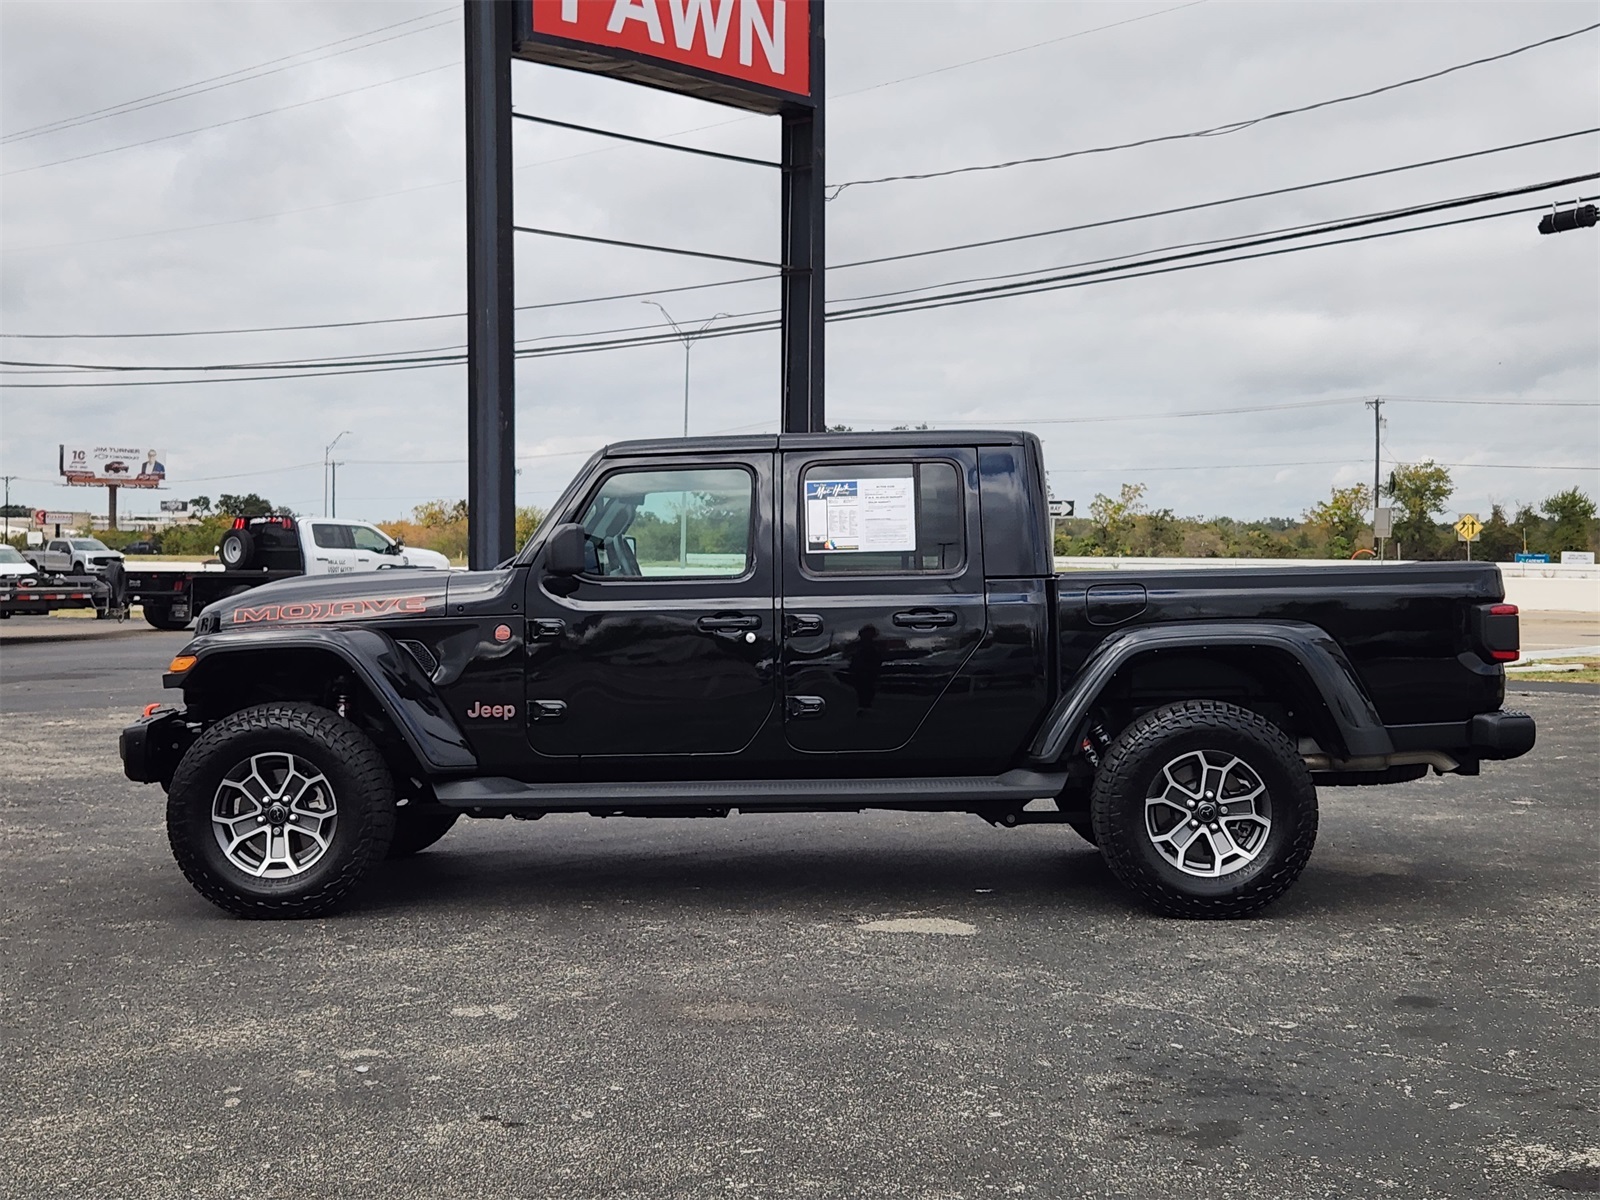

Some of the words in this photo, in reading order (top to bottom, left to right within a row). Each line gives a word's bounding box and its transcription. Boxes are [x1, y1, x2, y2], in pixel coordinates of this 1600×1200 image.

[561, 0, 787, 76] AWN
[233, 597, 427, 623] MOJAVE
[467, 702, 516, 720] Jeep
